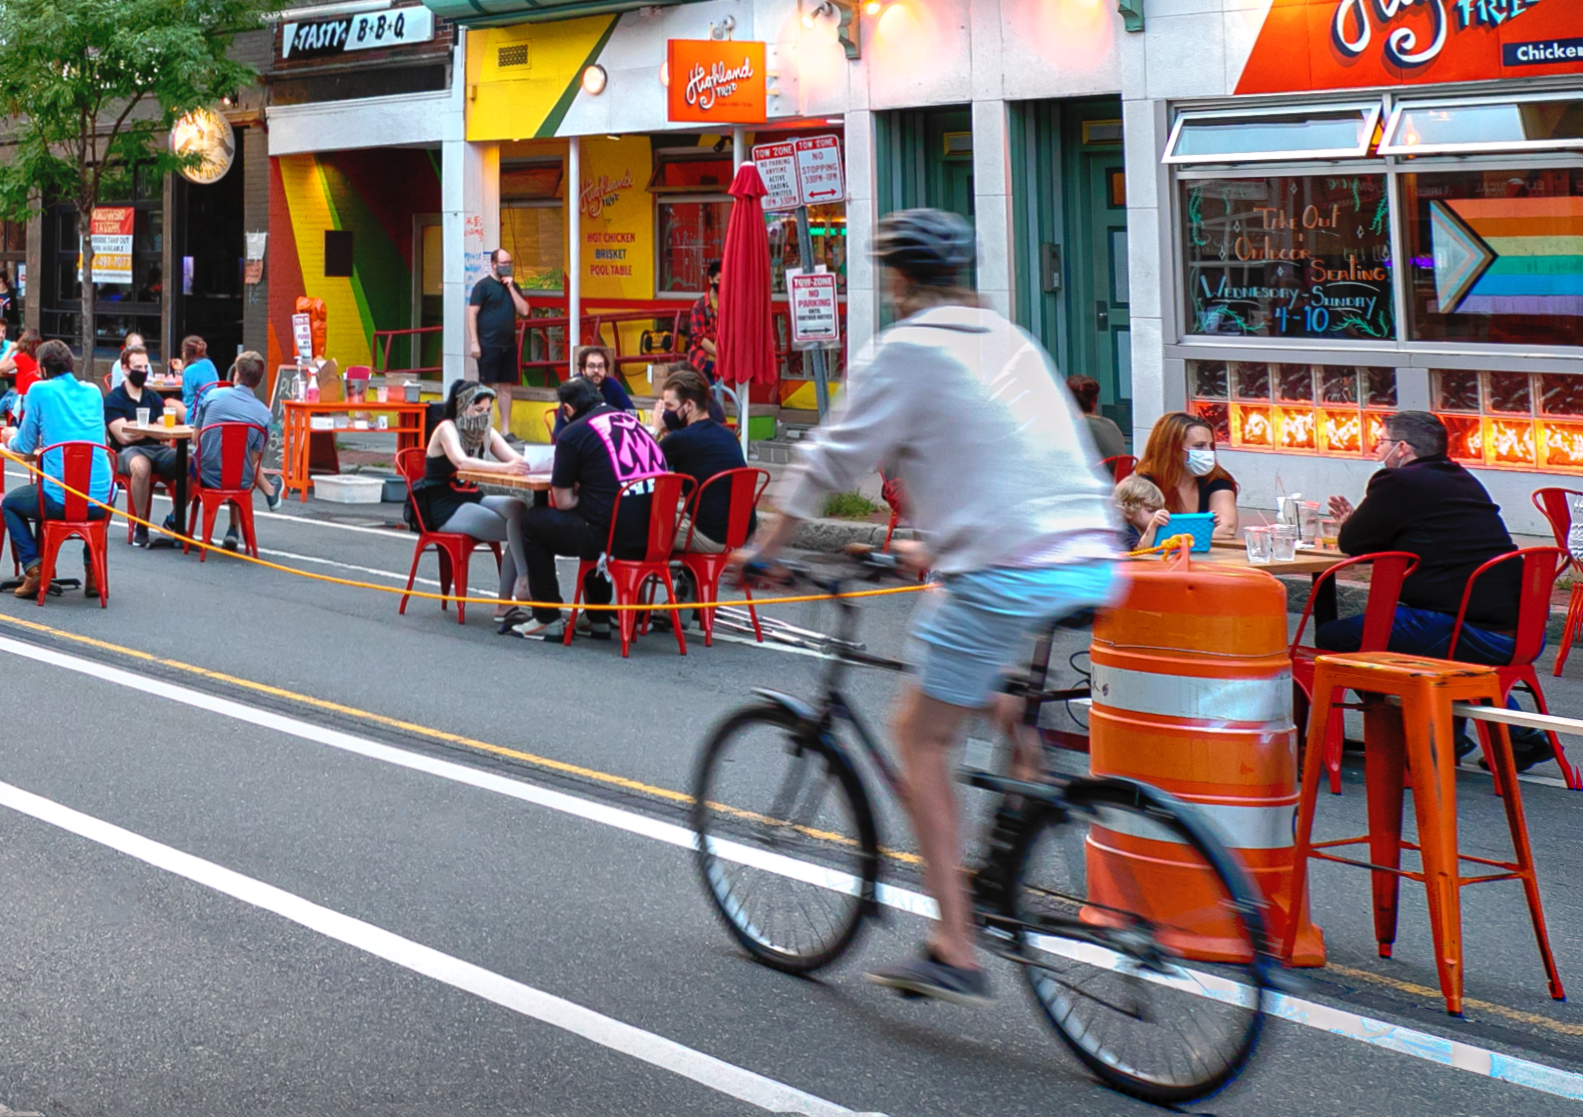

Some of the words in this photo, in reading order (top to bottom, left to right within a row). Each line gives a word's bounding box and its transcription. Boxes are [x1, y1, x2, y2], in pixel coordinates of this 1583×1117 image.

[298, 21, 347, 51] TASTY
[685, 56, 754, 110] Highland
[799, 141, 813, 150] TOW
[815, 138, 834, 148] ZONE
[756, 148, 770, 158] TOW
[772, 145, 793, 156] ZONE
[812, 151, 824, 161] NO
[769, 157, 791, 166] PARKING
[801, 163, 838, 175] STOPPING
[769, 174, 785, 183] ACTIVE
[94, 221, 122, 234] TAVERN
[587, 232, 602, 243] HOT
[603, 232, 635, 243] CHICKEN
[595, 248, 627, 260] BRISKET
[590, 265, 609, 276] POOL
[610, 265, 632, 276] TABLE
[794, 277, 832, 287] TOW-ZONE
[808, 290, 819, 298] NO
[798, 298, 831, 308] PARKING
